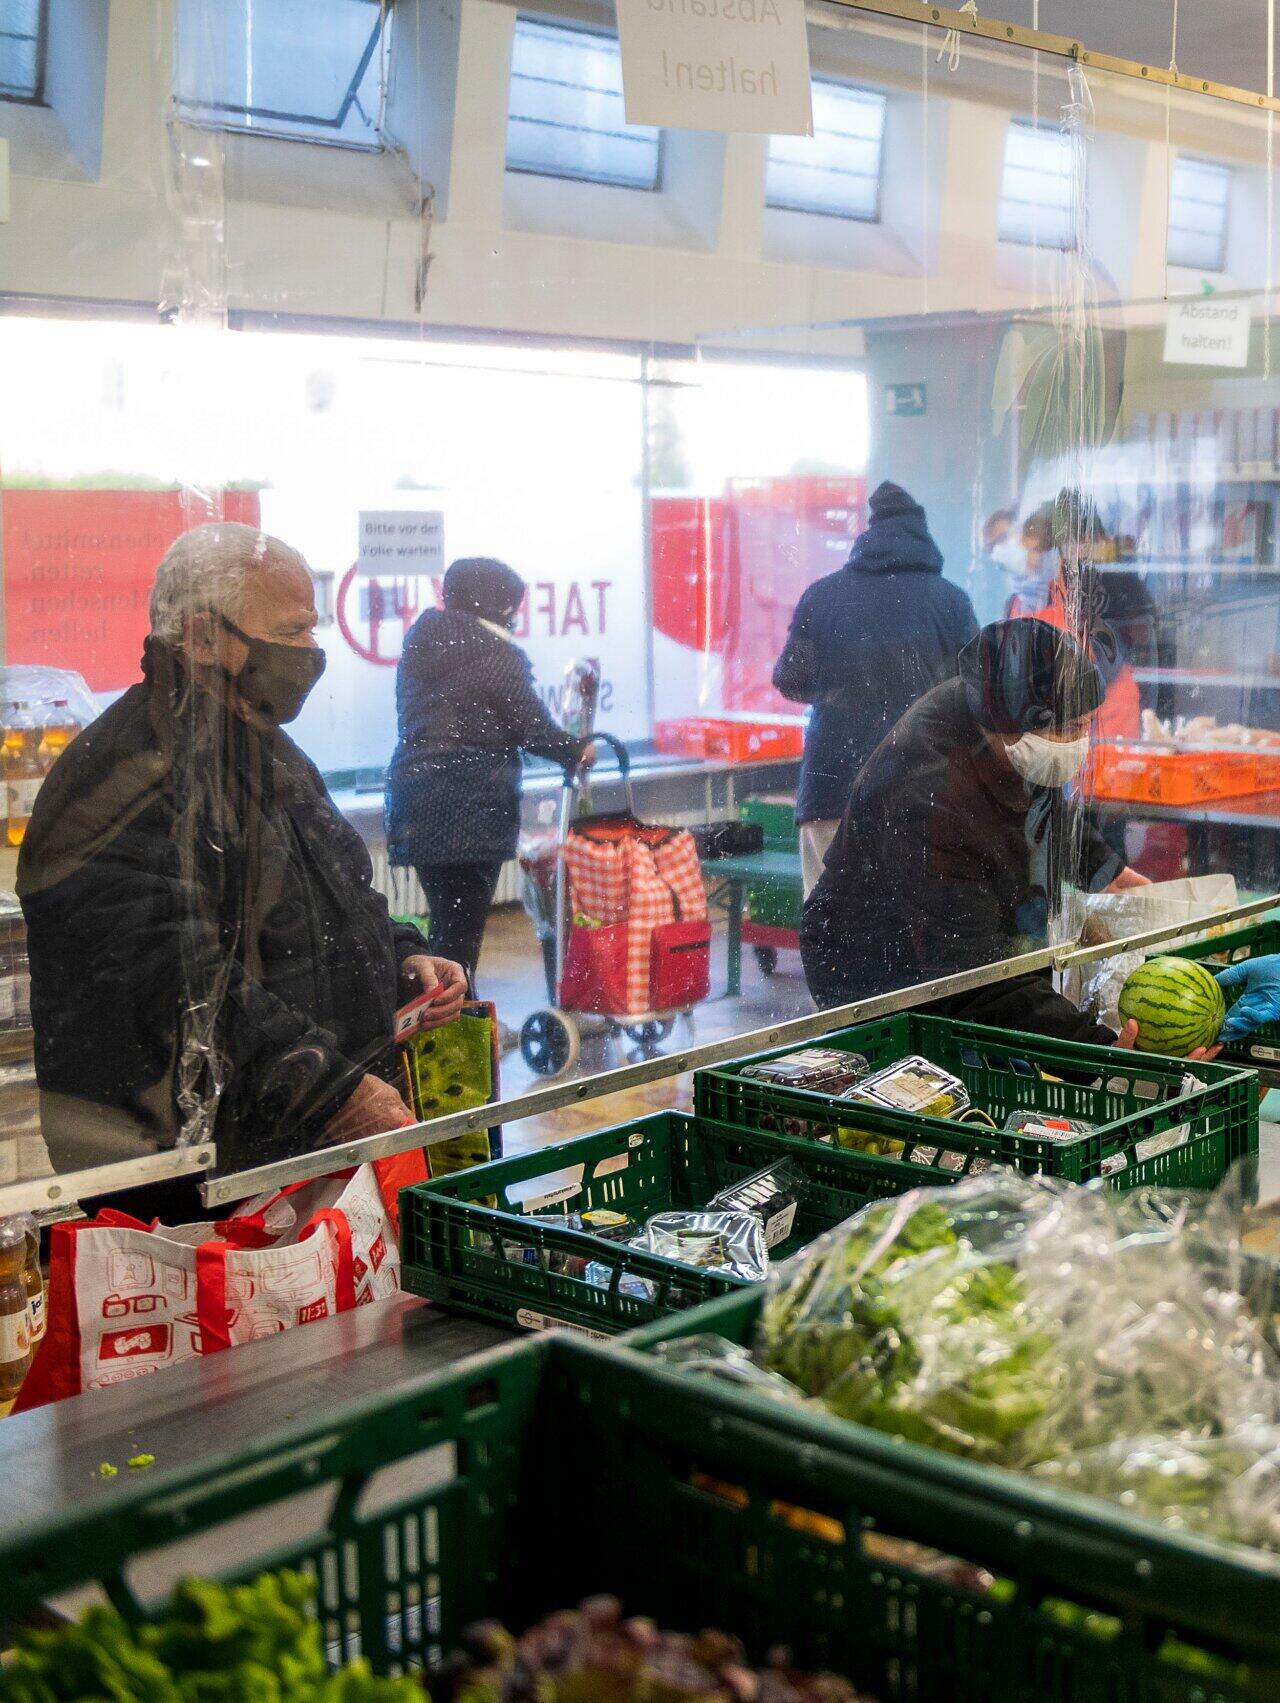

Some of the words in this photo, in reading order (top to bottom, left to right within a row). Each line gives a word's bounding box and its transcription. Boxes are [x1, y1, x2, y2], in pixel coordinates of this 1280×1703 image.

[1179, 303, 1238, 320] Abstand
[1182, 333, 1232, 351] halten!
[365, 522, 396, 535] Bitte
[399, 524, 417, 535] vor
[421, 522, 439, 534] der
[362, 544, 394, 557] Folie
[396, 544, 441, 556] warten!
